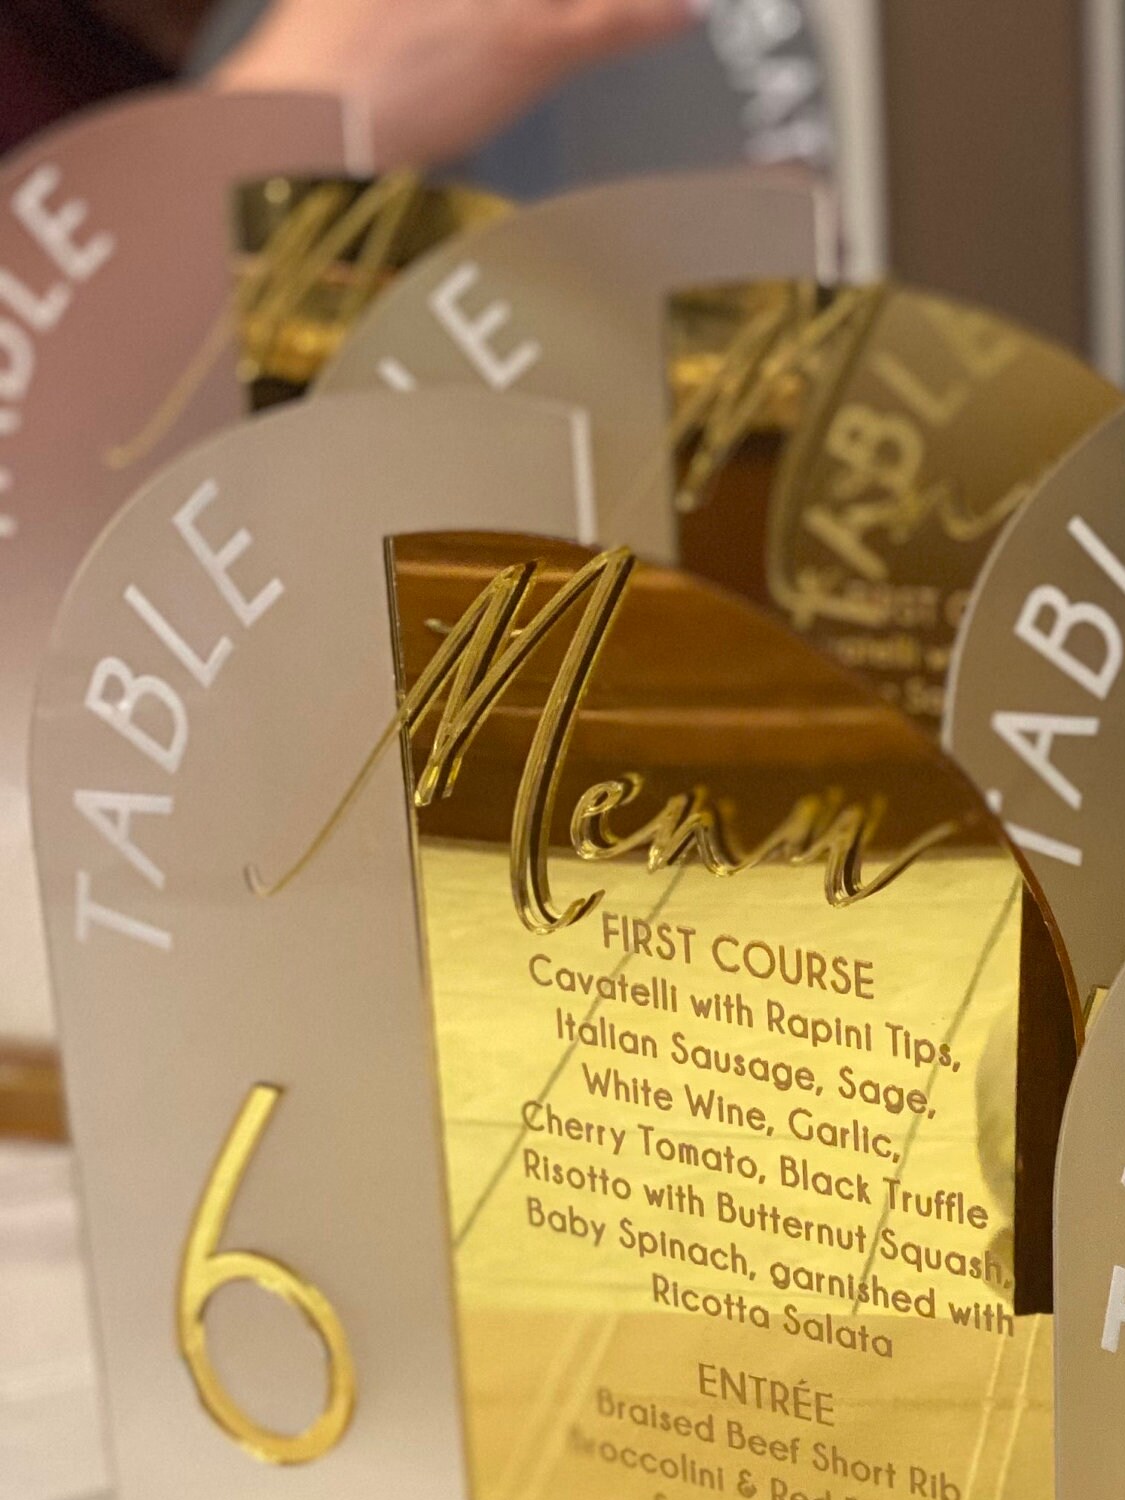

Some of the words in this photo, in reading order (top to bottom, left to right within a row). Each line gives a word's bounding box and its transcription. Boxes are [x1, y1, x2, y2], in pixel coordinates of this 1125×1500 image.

[73, 479, 285, 950] TABLE
[243, 545, 958, 935] Menu
[601, 911, 696, 964] FIRST
[712, 934, 875, 999] COURSE
[528, 953, 678, 1013] Cavatelli
[690, 993, 753, 1027] with
[767, 1001, 872, 1052] Rapini
[885, 1022, 961, 1073] Tips,
[557, 1008, 657, 1057] Italian
[671, 1031, 823, 1096] Sausage,
[839, 1066, 936, 1118] Sage,
[522, 1101, 626, 1154] Cherry
[637, 1124, 766, 1184] Tomato,
[780, 1155, 872, 1205] Black
[883, 1177, 988, 1229] Truffle
[582, 1062, 673, 1111] White
[685, 1083, 774, 1136] Wine,
[789, 1108, 901, 1163] Garlic,
[176, 1081, 357, 1466] 6
[524, 1149, 631, 1199] Risotto
[644, 1184, 704, 1217] with
[718, 1192, 866, 1254] Butternut
[880, 1229, 1012, 1289] Squash,
[527, 1197, 606, 1246] Baby
[619, 1218, 756, 1280] Spinach,
[770, 1261, 936, 1319] garnished
[948, 1301, 1014, 1337] with
[652, 1273, 769, 1329] Ricotta
[783, 1304, 892, 1358] Salata
[597, 1387, 714, 1442] Braised
[727, 1419, 800, 1464] Beef
[812, 1443, 896, 1488] Short
[698, 1362, 834, 1427] ENTRÉE
[737, 1469, 756, 1498] &
